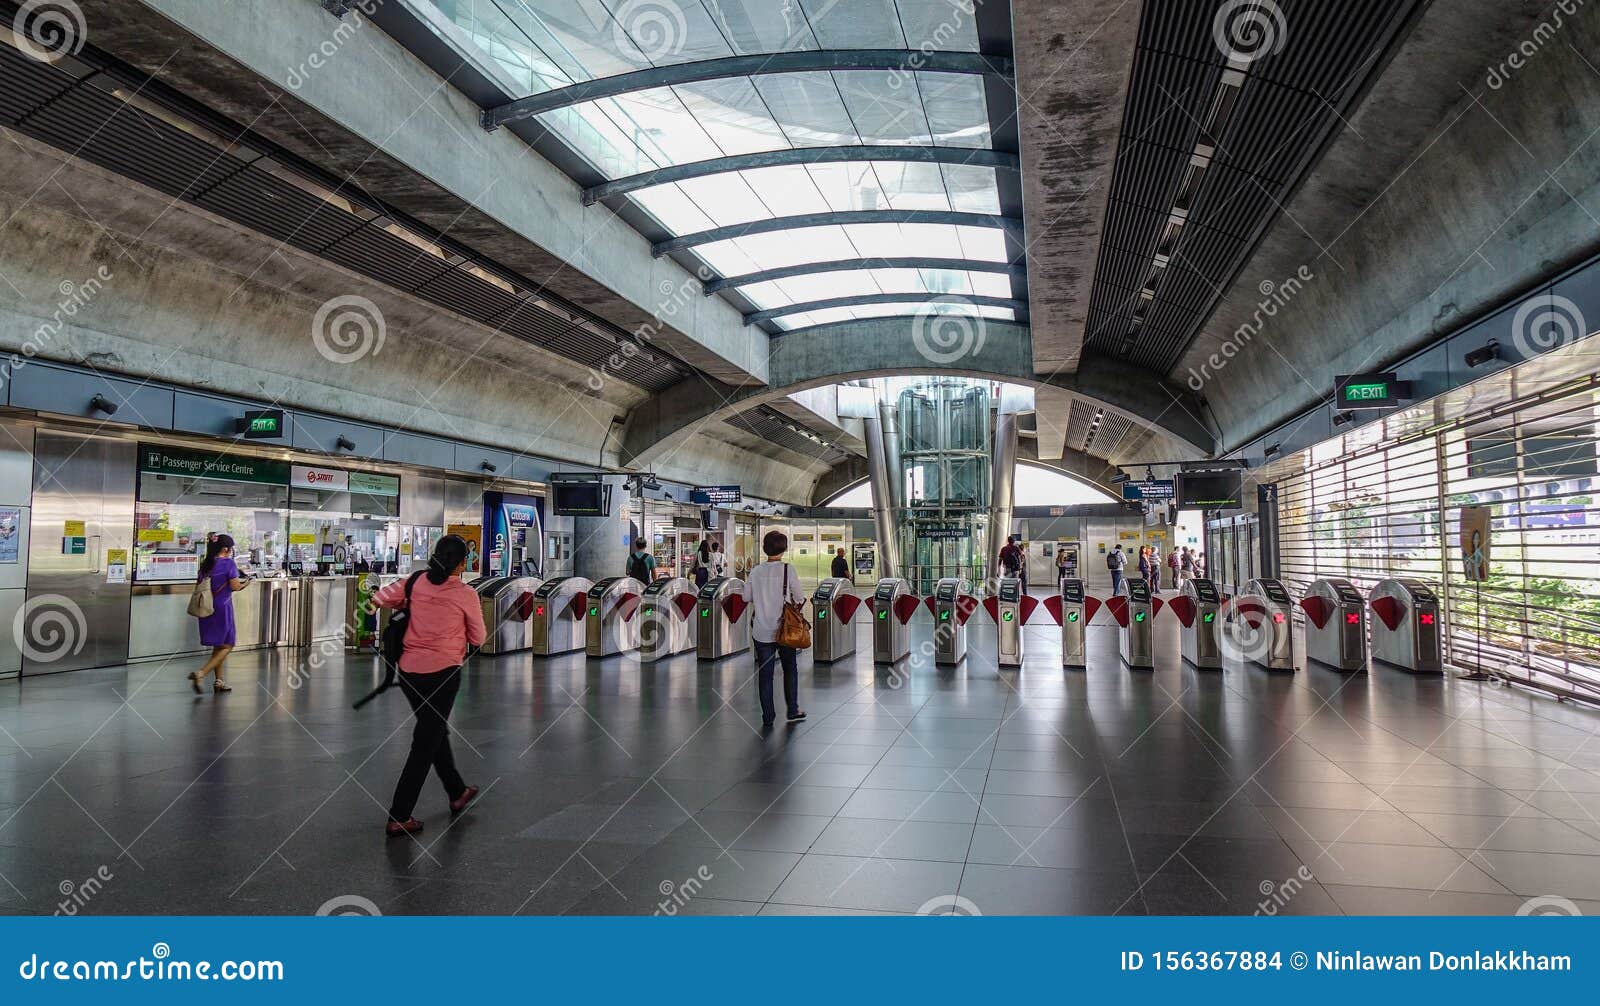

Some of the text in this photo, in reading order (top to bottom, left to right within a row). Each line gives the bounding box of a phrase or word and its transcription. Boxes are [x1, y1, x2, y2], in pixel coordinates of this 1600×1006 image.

[1361, 386, 1384, 399] EXIT
[251, 420, 266, 431] EXIT
[162, 455, 254, 475] Passenger Service Centre
